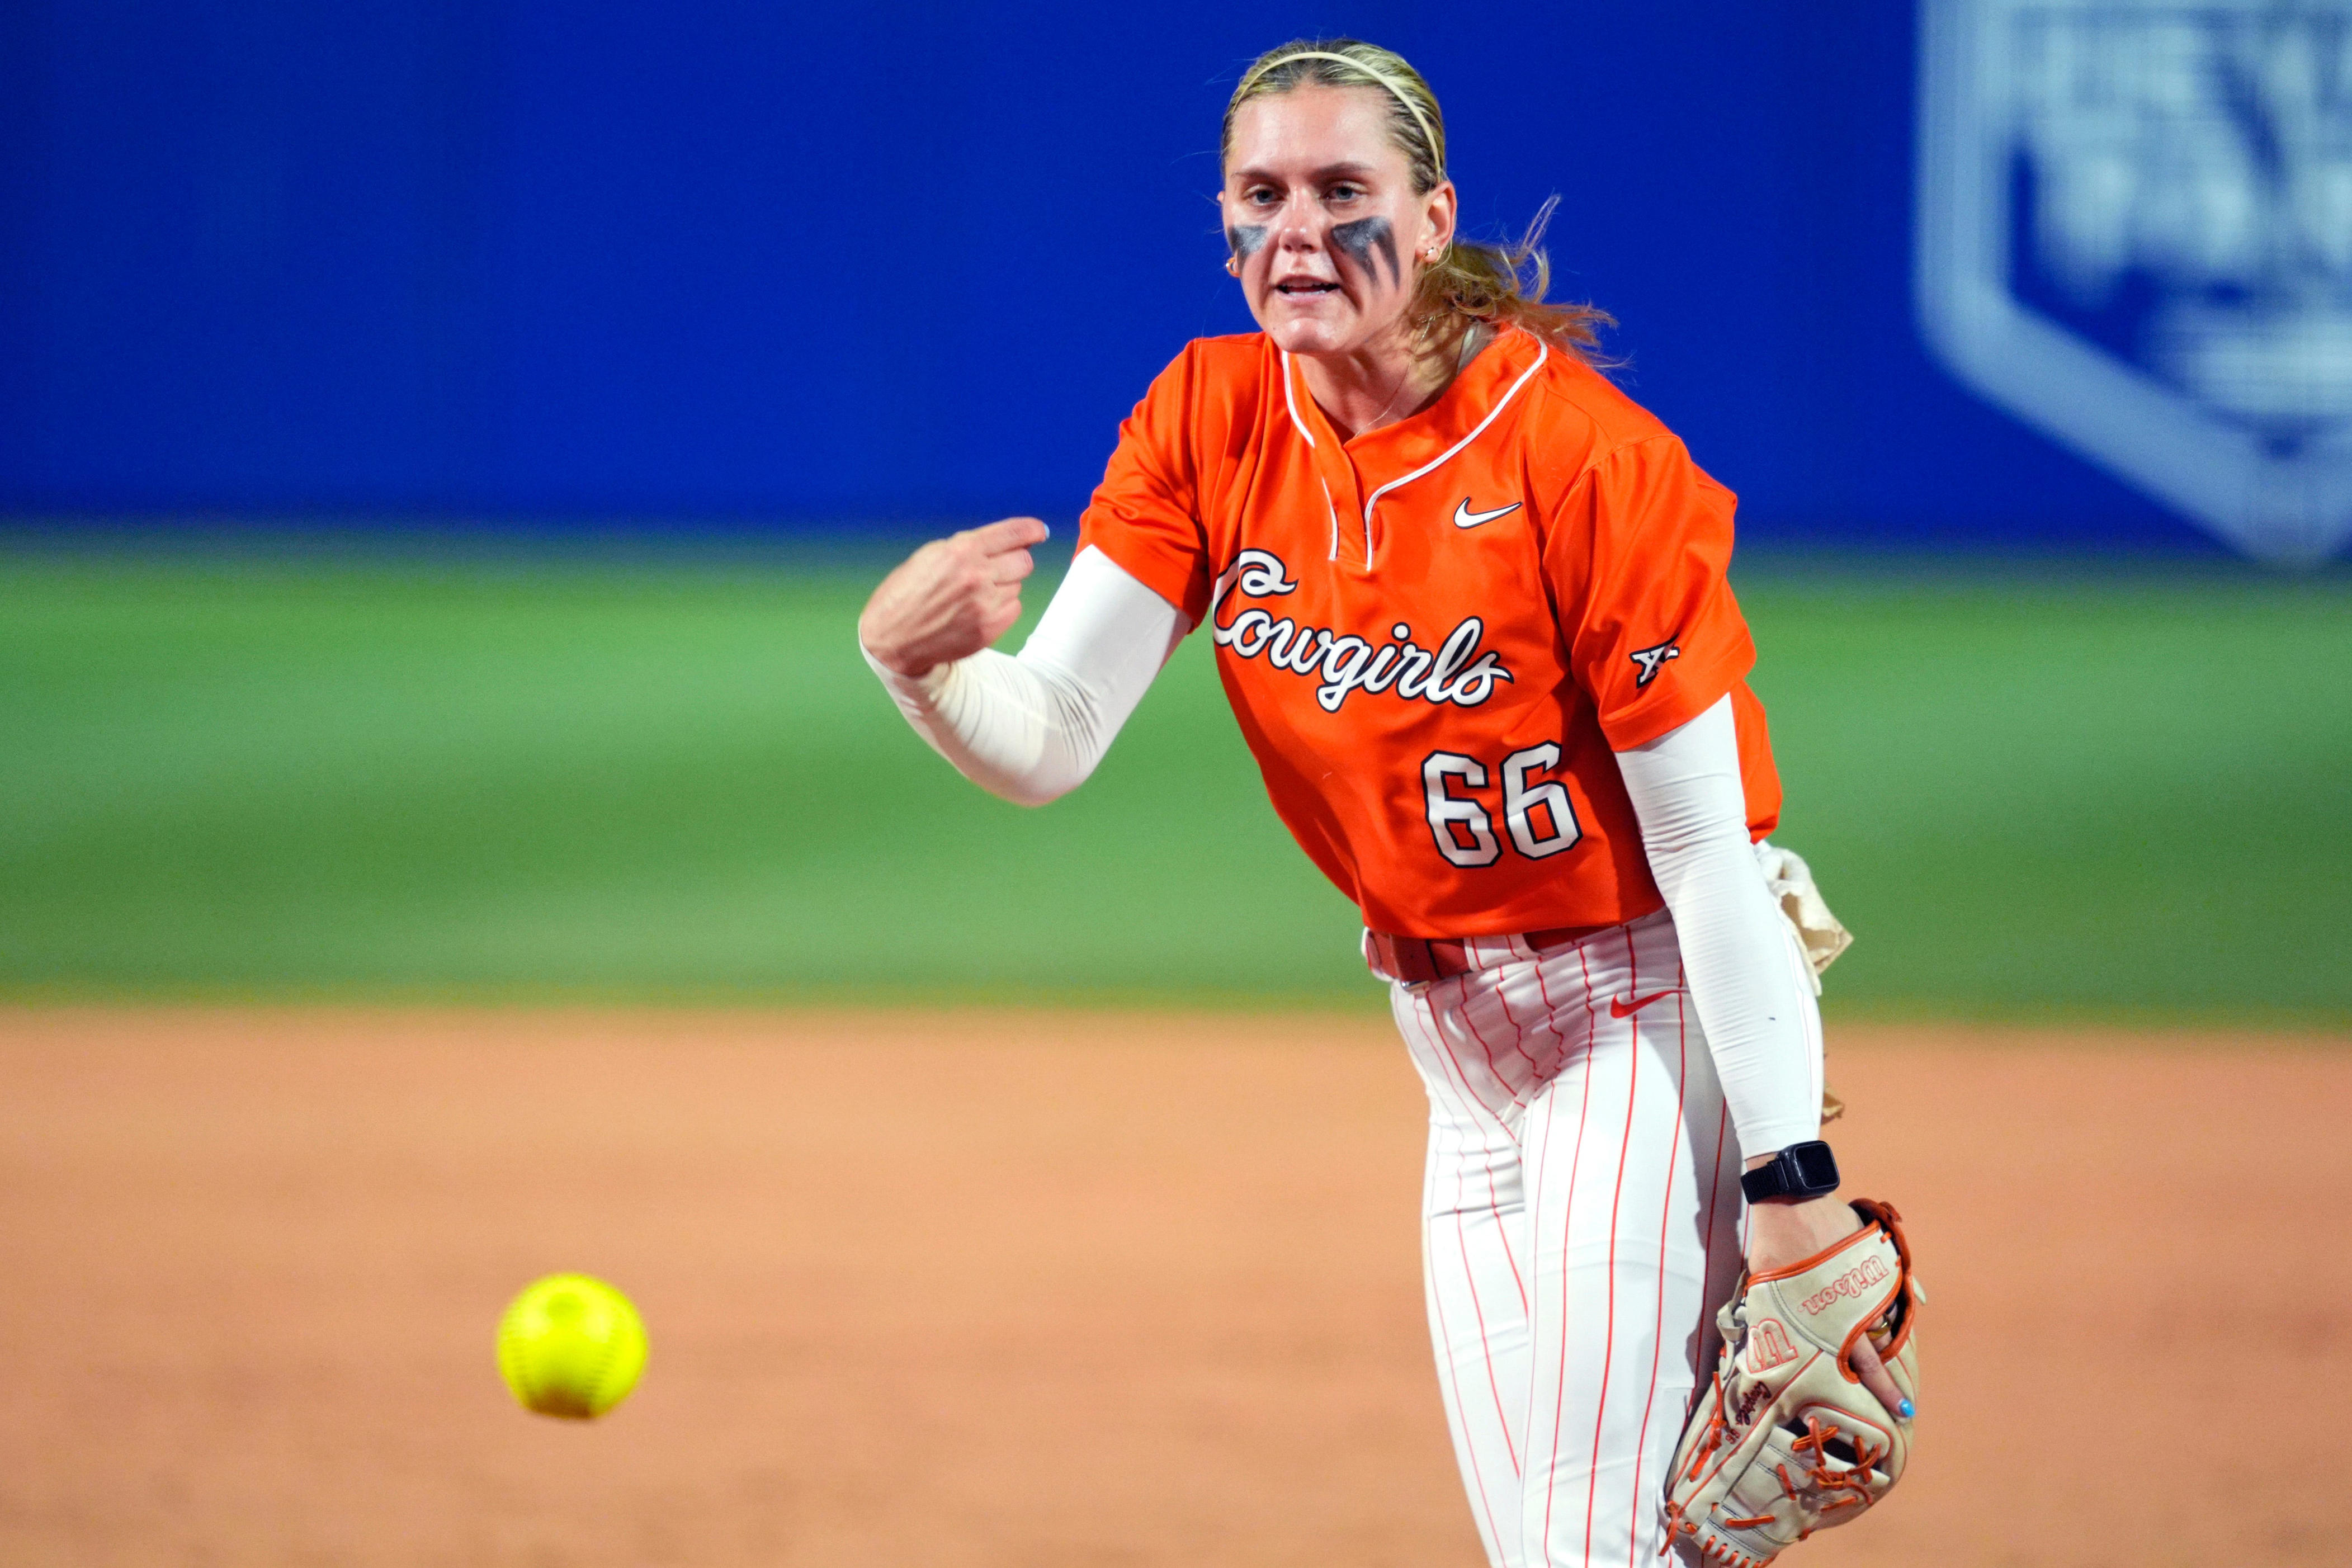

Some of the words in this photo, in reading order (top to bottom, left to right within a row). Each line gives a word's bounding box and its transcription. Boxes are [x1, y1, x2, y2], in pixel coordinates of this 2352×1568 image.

[1212, 547, 1514, 714] Cowgirls
[1420, 740, 1583, 868] 66
[1801, 1255, 1890, 1315] Wilson
